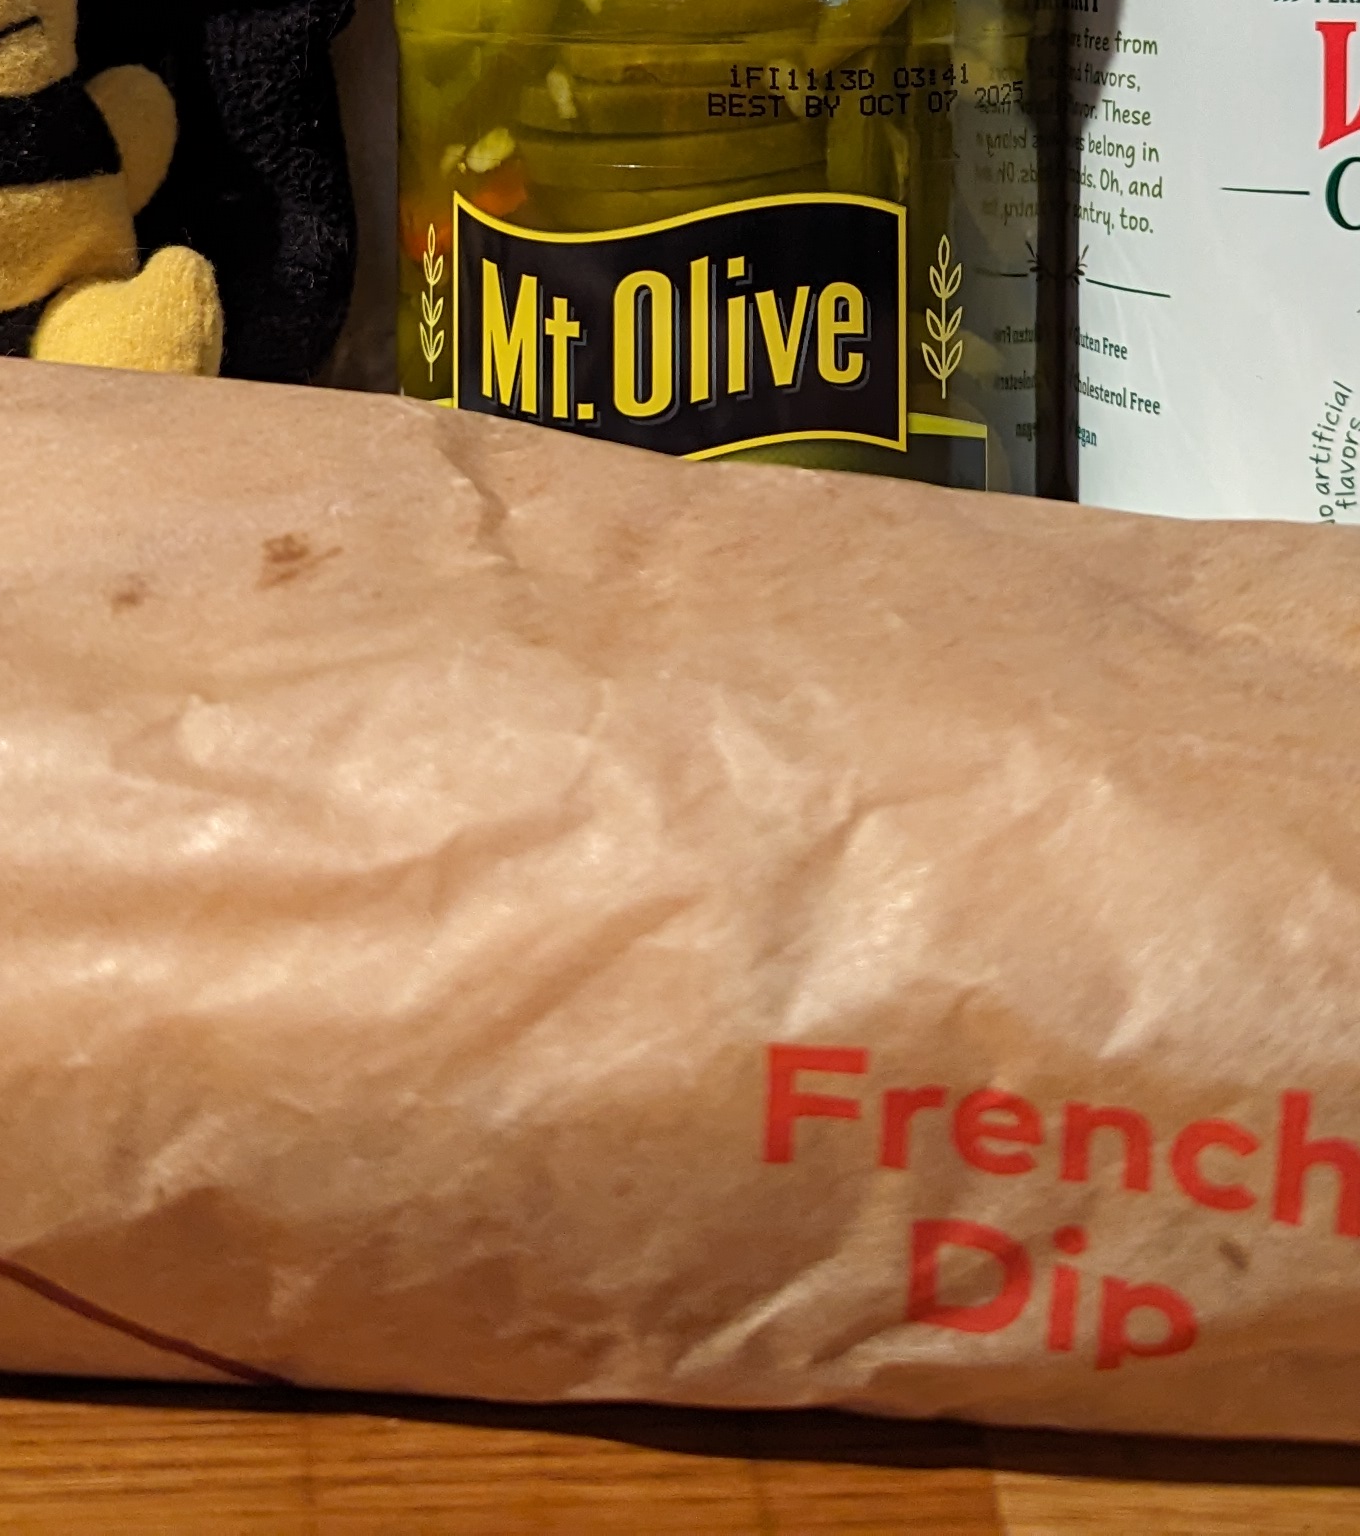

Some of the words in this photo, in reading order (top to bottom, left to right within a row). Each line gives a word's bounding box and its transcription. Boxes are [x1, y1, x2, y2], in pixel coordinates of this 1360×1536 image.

[1084, 28, 1110, 51] free
[1114, 31, 1159, 56] from
[893, 62, 969, 89] 03:41
[1084, 62, 1141, 92] flavors,
[707, 92, 785, 118] BEST
[804, 93, 841, 118] BY
[859, 92, 911, 115] OCT
[927, 89, 958, 114] 07
[974, 80, 1025, 106] 2025
[1102, 99, 1153, 127] These
[1088, 132, 1136, 169] belong
[1143, 141, 1160, 163] in
[1099, 168, 1124, 197] Oh,
[1128, 176, 1164, 199] and
[1120, 207, 1154, 234] too.
[481, 258, 595, 421] Mt.
[613, 255, 866, 420] Olive
[1102, 337, 1128, 360] Free
[1130, 392, 1161, 415] Free
[1076, 424, 1097, 448] egan
[1309, 380, 1353, 496] artificial
[904, 1217, 1198, 1371] Dip
